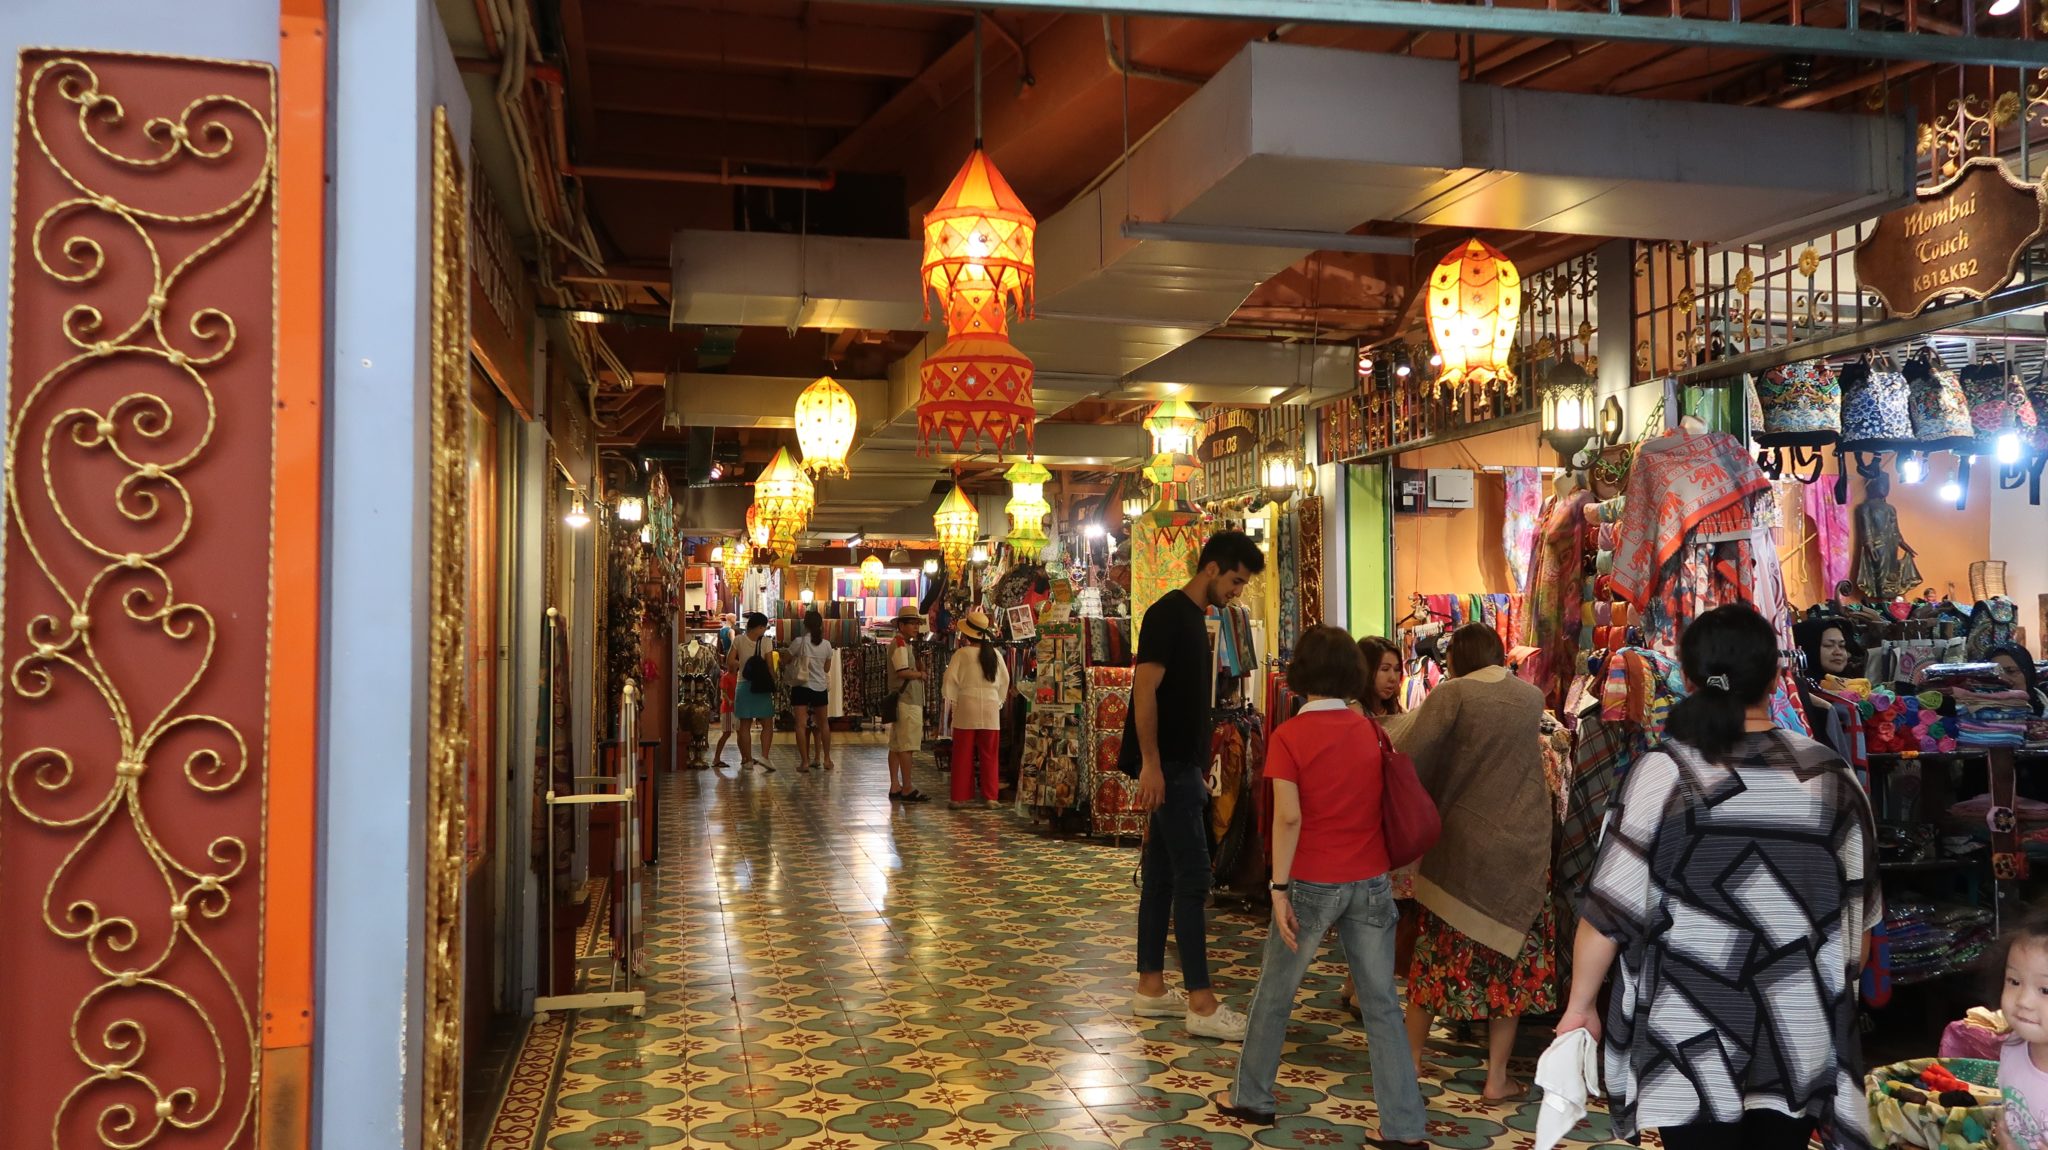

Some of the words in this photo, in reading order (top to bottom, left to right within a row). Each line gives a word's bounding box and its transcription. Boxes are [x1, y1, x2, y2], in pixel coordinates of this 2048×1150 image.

[1915, 228, 1968, 263] Touch
[1912, 258, 1978, 293] KB1&KB2
[1213, 436, 1237, 457] KB.03
